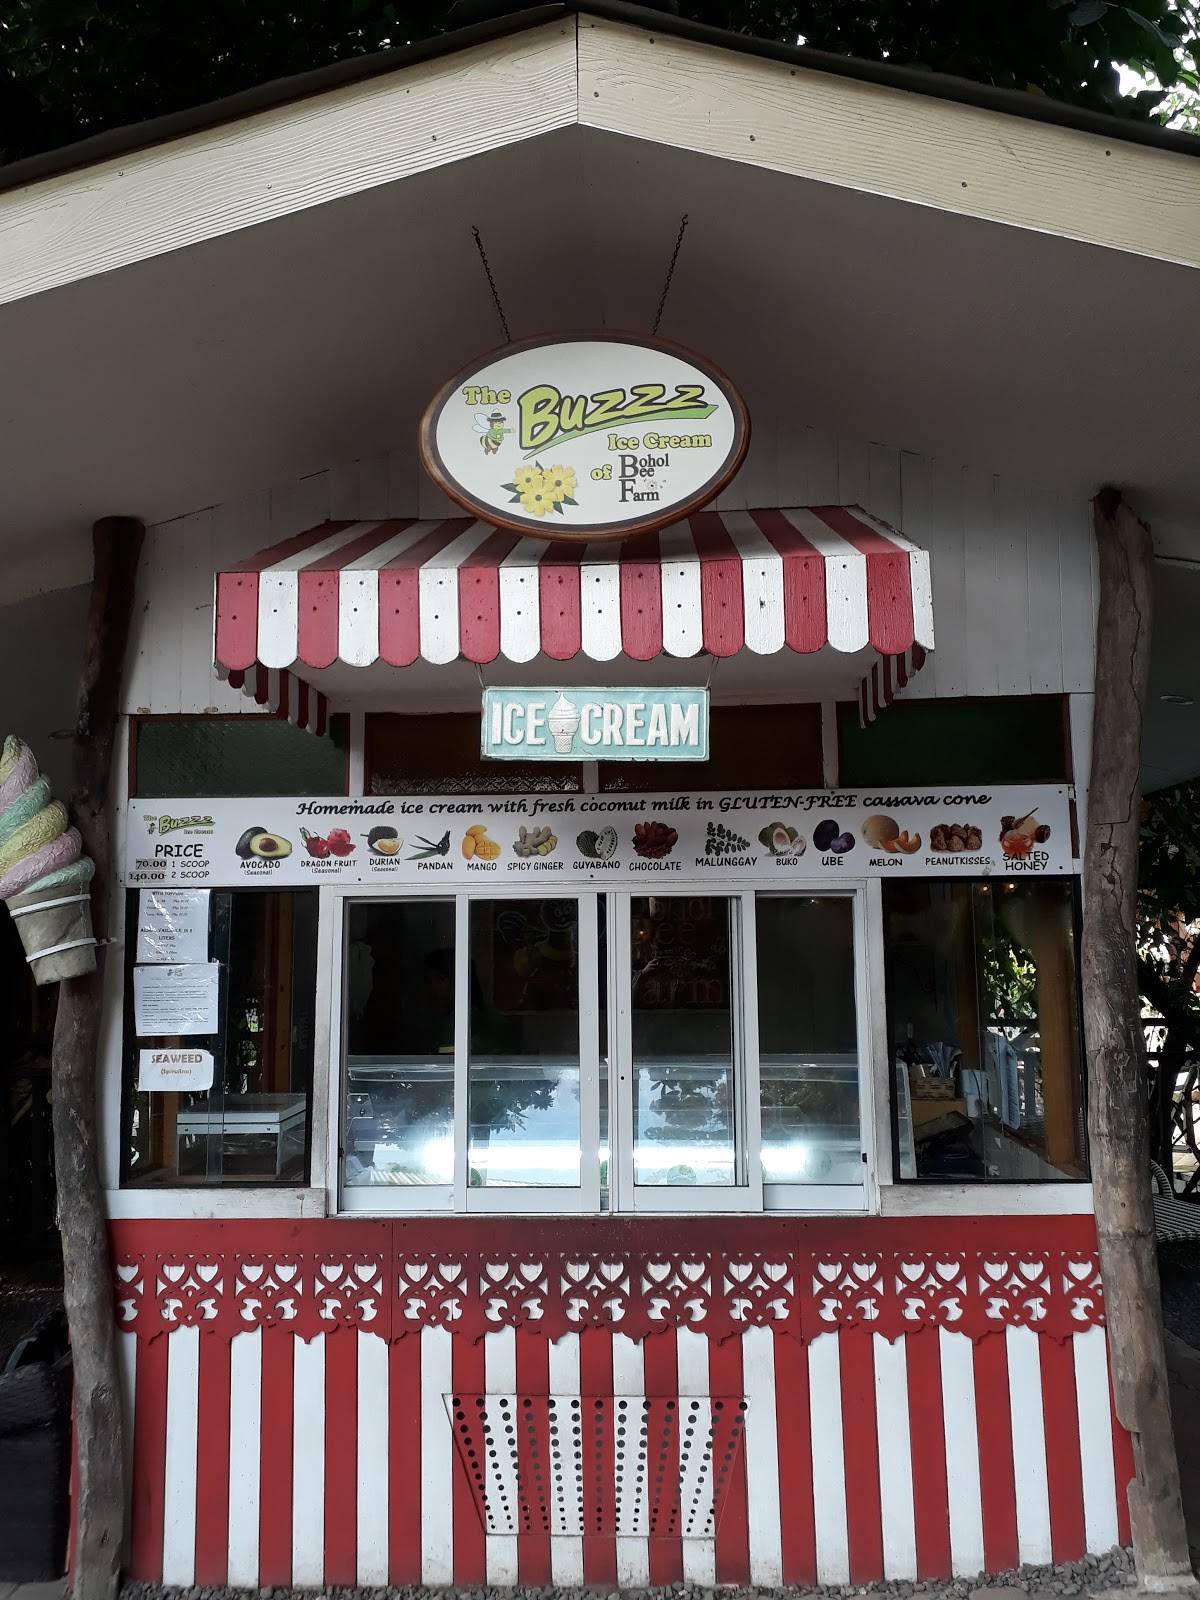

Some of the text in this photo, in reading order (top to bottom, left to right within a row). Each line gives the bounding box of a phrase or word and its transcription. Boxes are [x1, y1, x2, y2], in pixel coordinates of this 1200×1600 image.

[463, 383, 709, 450] The Buzzz
[608, 431, 713, 451] Ice Cream
[618, 453, 670, 479] Bohol
[590, 463, 613, 481] of
[618, 479, 661, 503] Farm
[491, 702, 700, 747] ICE CREAM
[296, 793, 993, 817] Homemade ice cream with fresh coconut milk in GLUTEN-FREE cassava cone
[158, 814, 214, 834] Buzzz
[154, 843, 204, 858] PRICE
[776, 857, 798, 866] BUKO
[822, 857, 844, 866] UBE
[1002, 852, 1050, 861] SALTED
[136, 859, 210, 870] 70.00 1 SCOOP
[240, 861, 281, 869] AVOCADO
[301, 860, 357, 868] DRAGON FRUIT
[369, 858, 400, 866] DURIAN
[417, 862, 454, 871] PANDAN
[466, 862, 498, 871] MANGO
[507, 862, 564, 871] SPICY GINGER
[572, 860, 621, 870] GUYABANO
[629, 861, 682, 871] CHOCOLATE
[695, 857, 757, 867] MALUNGGAY
[869, 857, 903, 867] MELON
[1005, 861, 1048, 871] HONEY
[171, 871, 177, 879] 2
[180, 870, 210, 879] SCOOP
[151, 1054, 203, 1064] SEAWEED
